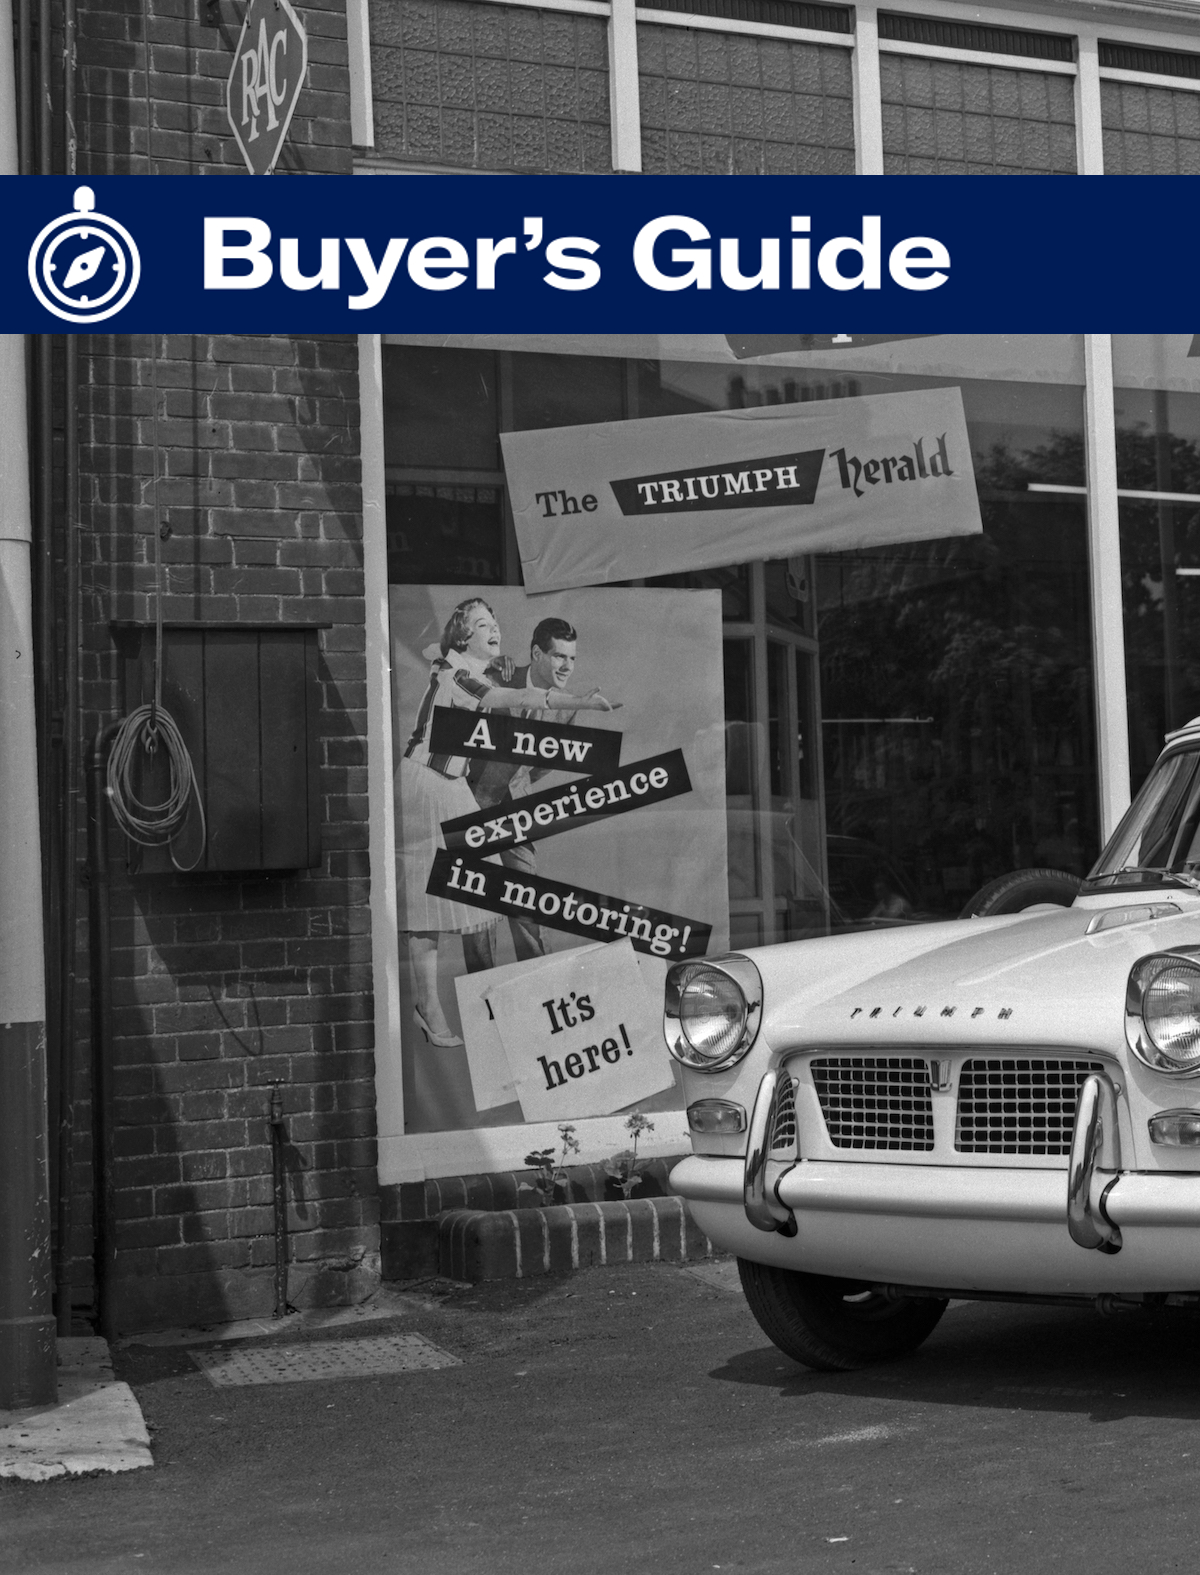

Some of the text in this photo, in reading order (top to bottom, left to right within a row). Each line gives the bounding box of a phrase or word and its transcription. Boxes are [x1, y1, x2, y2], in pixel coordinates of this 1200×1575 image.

[240, 17, 288, 143] RAC
[535, 432, 955, 518] The TRIUMPH herald
[463, 718, 593, 763] A new
[464, 766, 669, 848] experience
[446, 858, 692, 956] in motoring!
[542, 991, 595, 1035] It's
[850, 1005, 1013, 1020] TRIUMPH
[536, 1023, 634, 1091] here!
